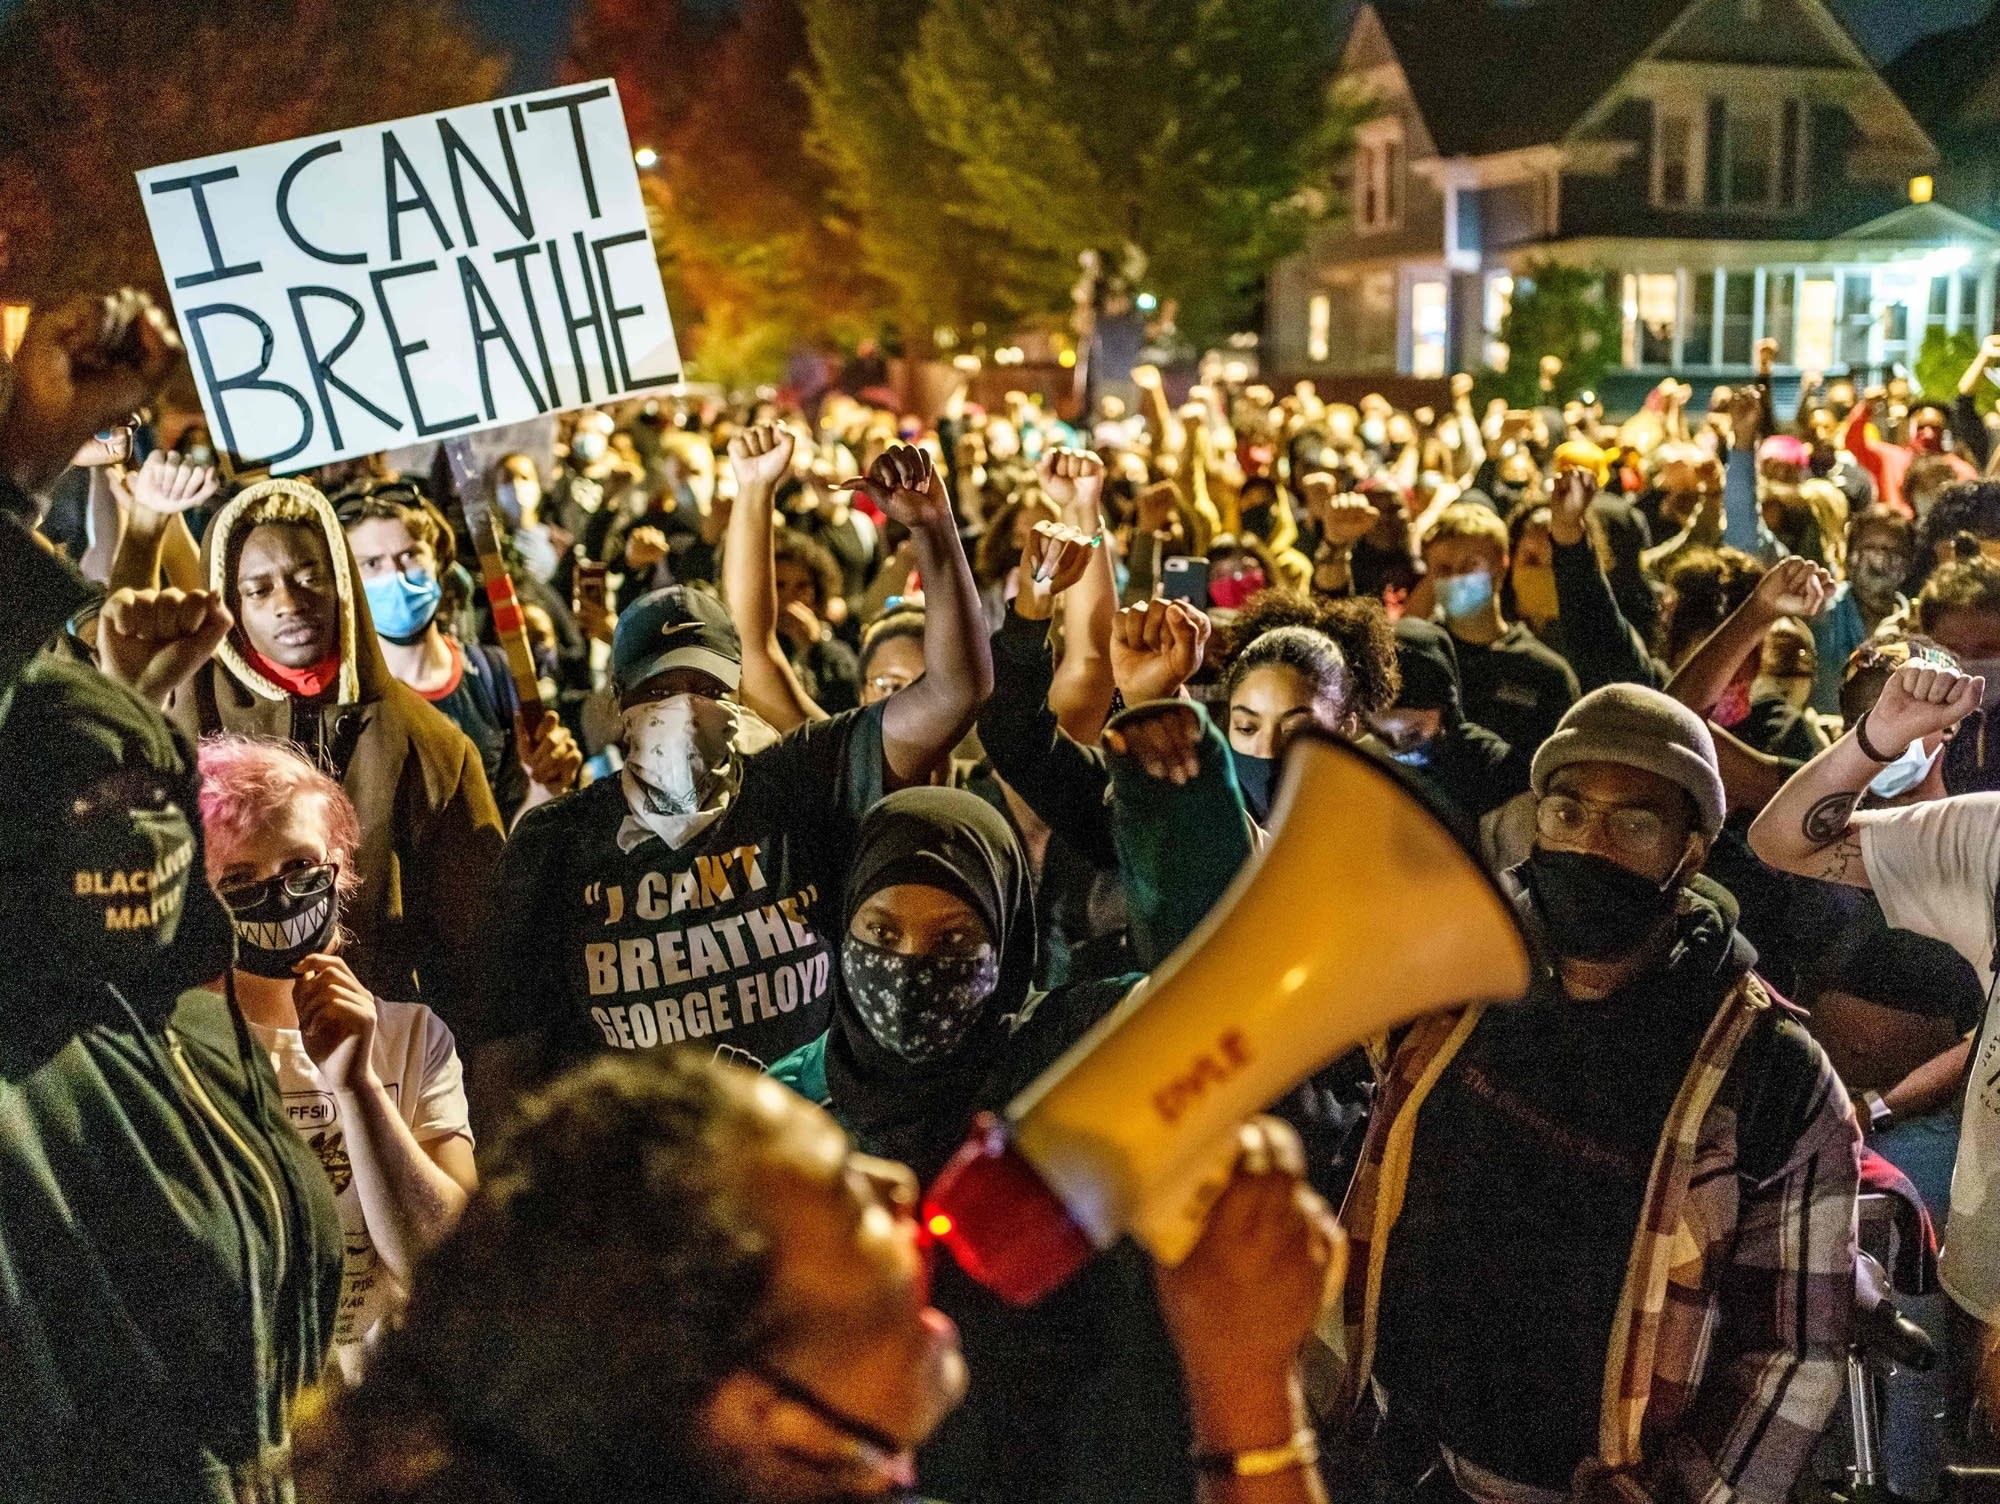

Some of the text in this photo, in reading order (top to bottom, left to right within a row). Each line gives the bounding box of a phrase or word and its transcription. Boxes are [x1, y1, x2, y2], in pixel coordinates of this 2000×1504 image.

[151, 86, 610, 288] I CAN'T
[185, 230, 680, 470] BREATHE
[636, 844, 767, 920] CAN'T
[590, 951, 829, 1049] GEORGE FLOYD
